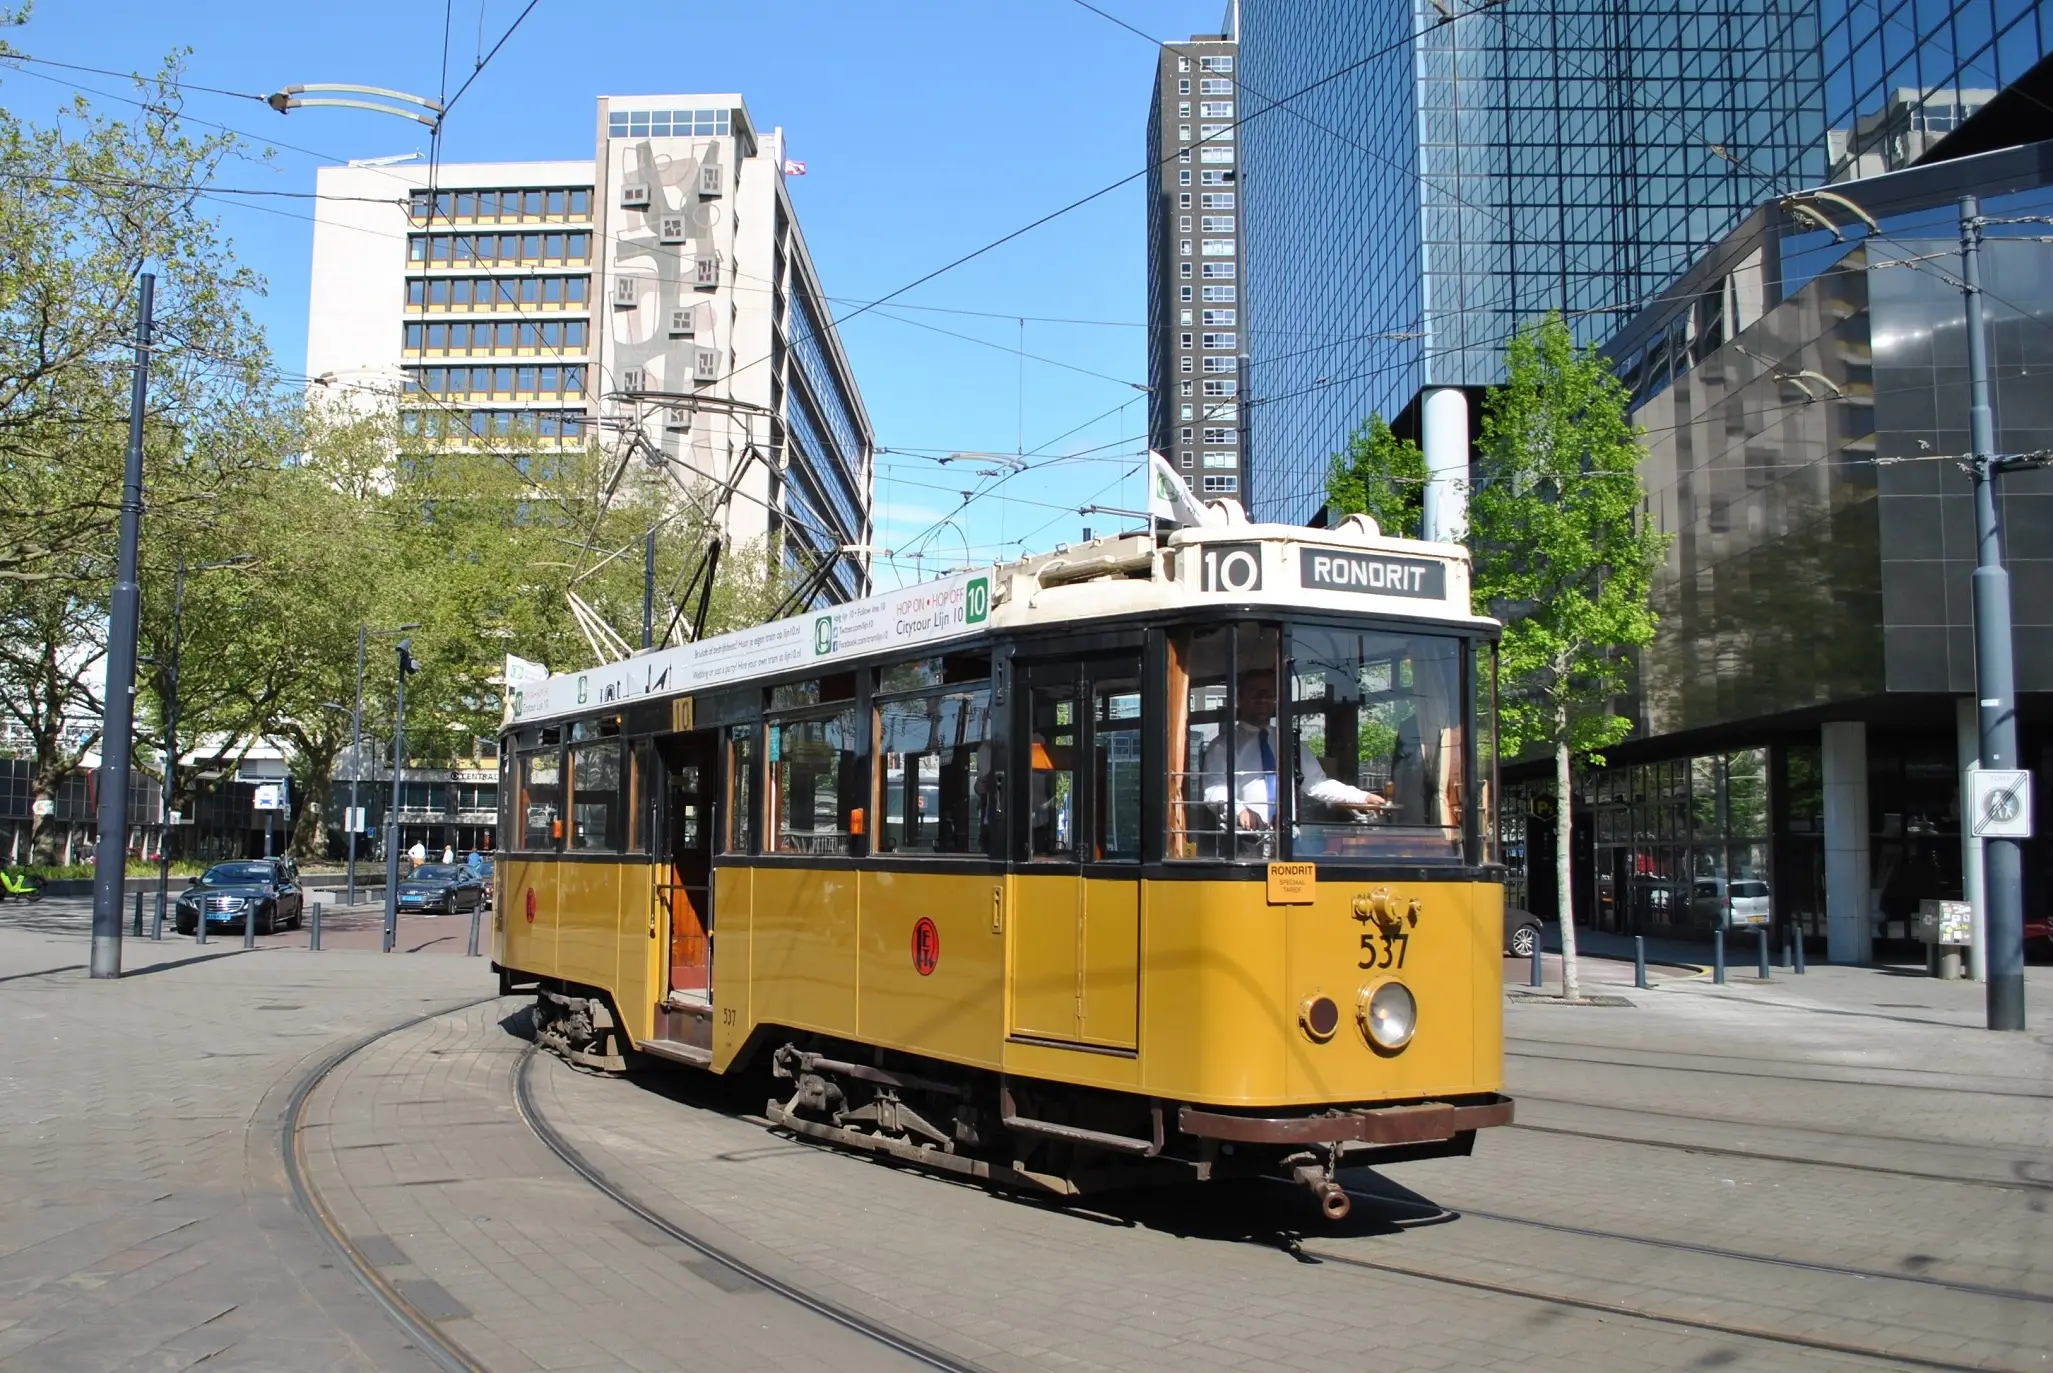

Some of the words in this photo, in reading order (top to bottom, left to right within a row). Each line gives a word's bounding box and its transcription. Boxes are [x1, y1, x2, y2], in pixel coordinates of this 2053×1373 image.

[1204, 550, 1258, 592] 10
[1313, 556, 1425, 592] RONDRIT
[896, 600, 912, 616] HOP
[913, 597, 925, 612] ON
[932, 591, 949, 607] HOP
[949, 587, 964, 604] OFF
[967, 585, 986, 617] 10
[896, 618, 931, 638] Citytour
[934, 612, 949, 630] Lijn
[953, 606, 964, 623] 10
[675, 701, 690, 730] 10
[1271, 866, 1313, 875] RONDRIT
[1358, 934, 1408, 969] 537
[723, 1008, 736, 1027] 537
